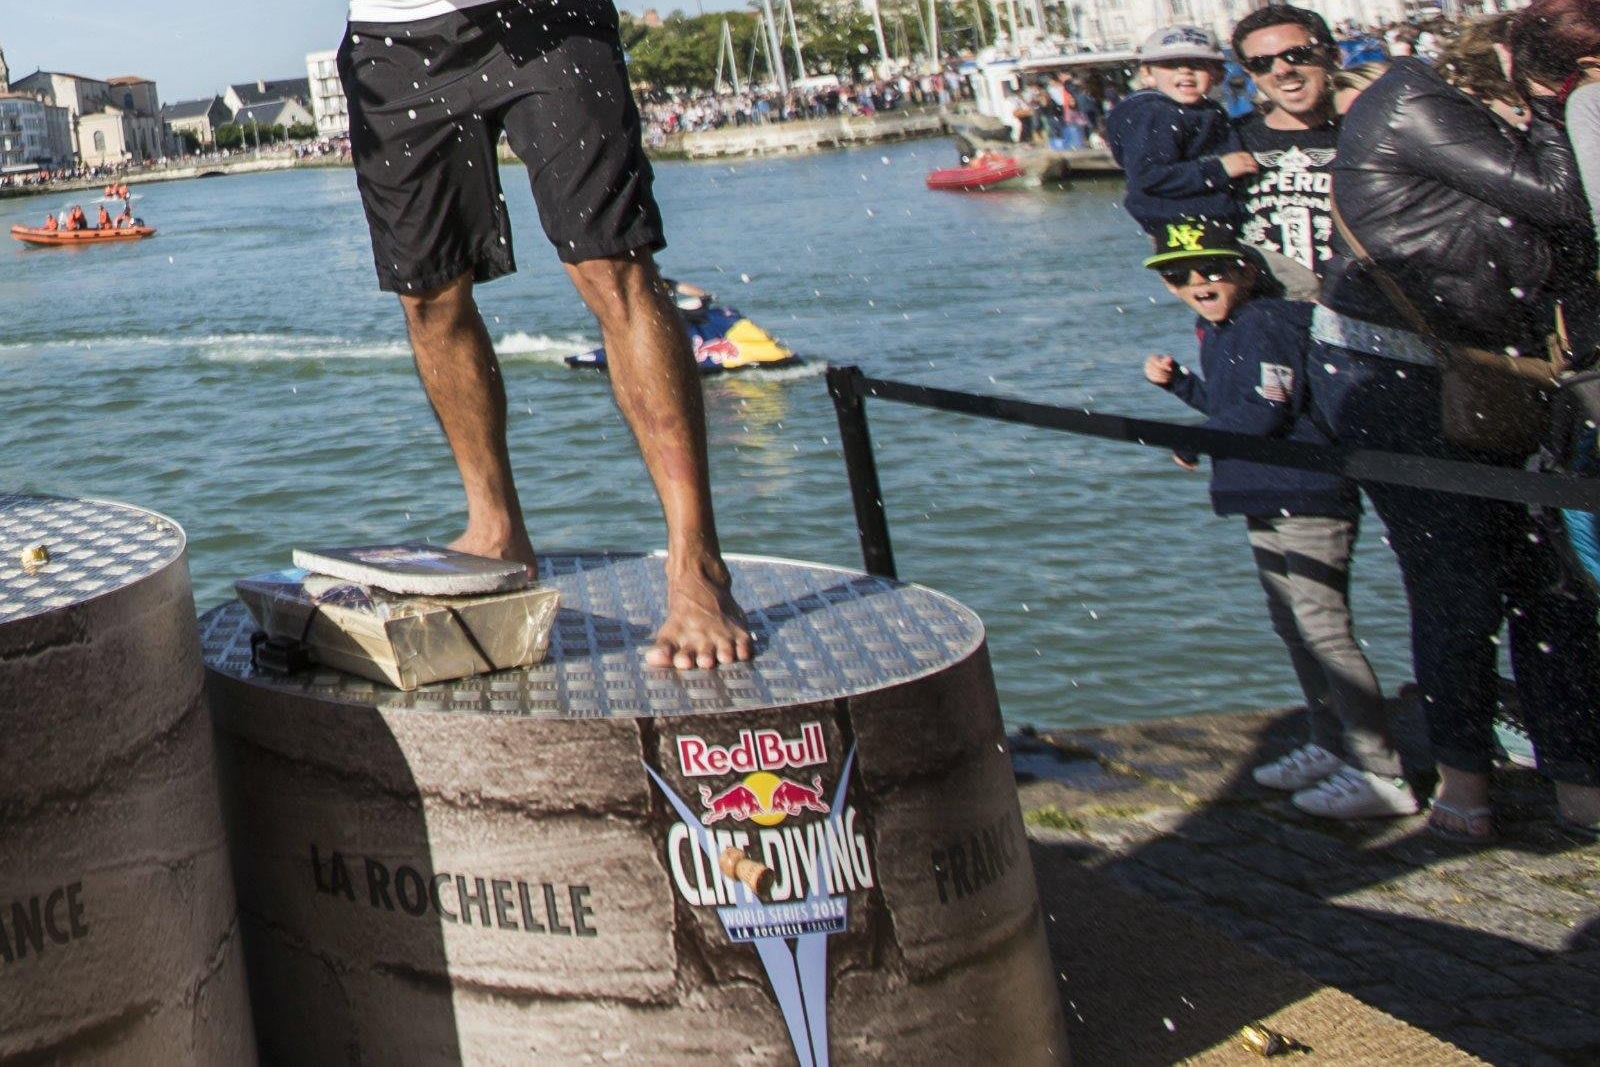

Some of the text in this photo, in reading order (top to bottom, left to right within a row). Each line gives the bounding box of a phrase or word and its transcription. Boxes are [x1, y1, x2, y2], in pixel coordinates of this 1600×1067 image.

[1166, 222, 1204, 250] NY
[679, 723, 826, 774] Red Bull
[760, 805, 874, 901] DIVING
[310, 842, 598, 937] LA ROCHELLE
[724, 900, 844, 926] WORLD SERIES 2015
[754, 924, 803, 938] ROCHELLE
